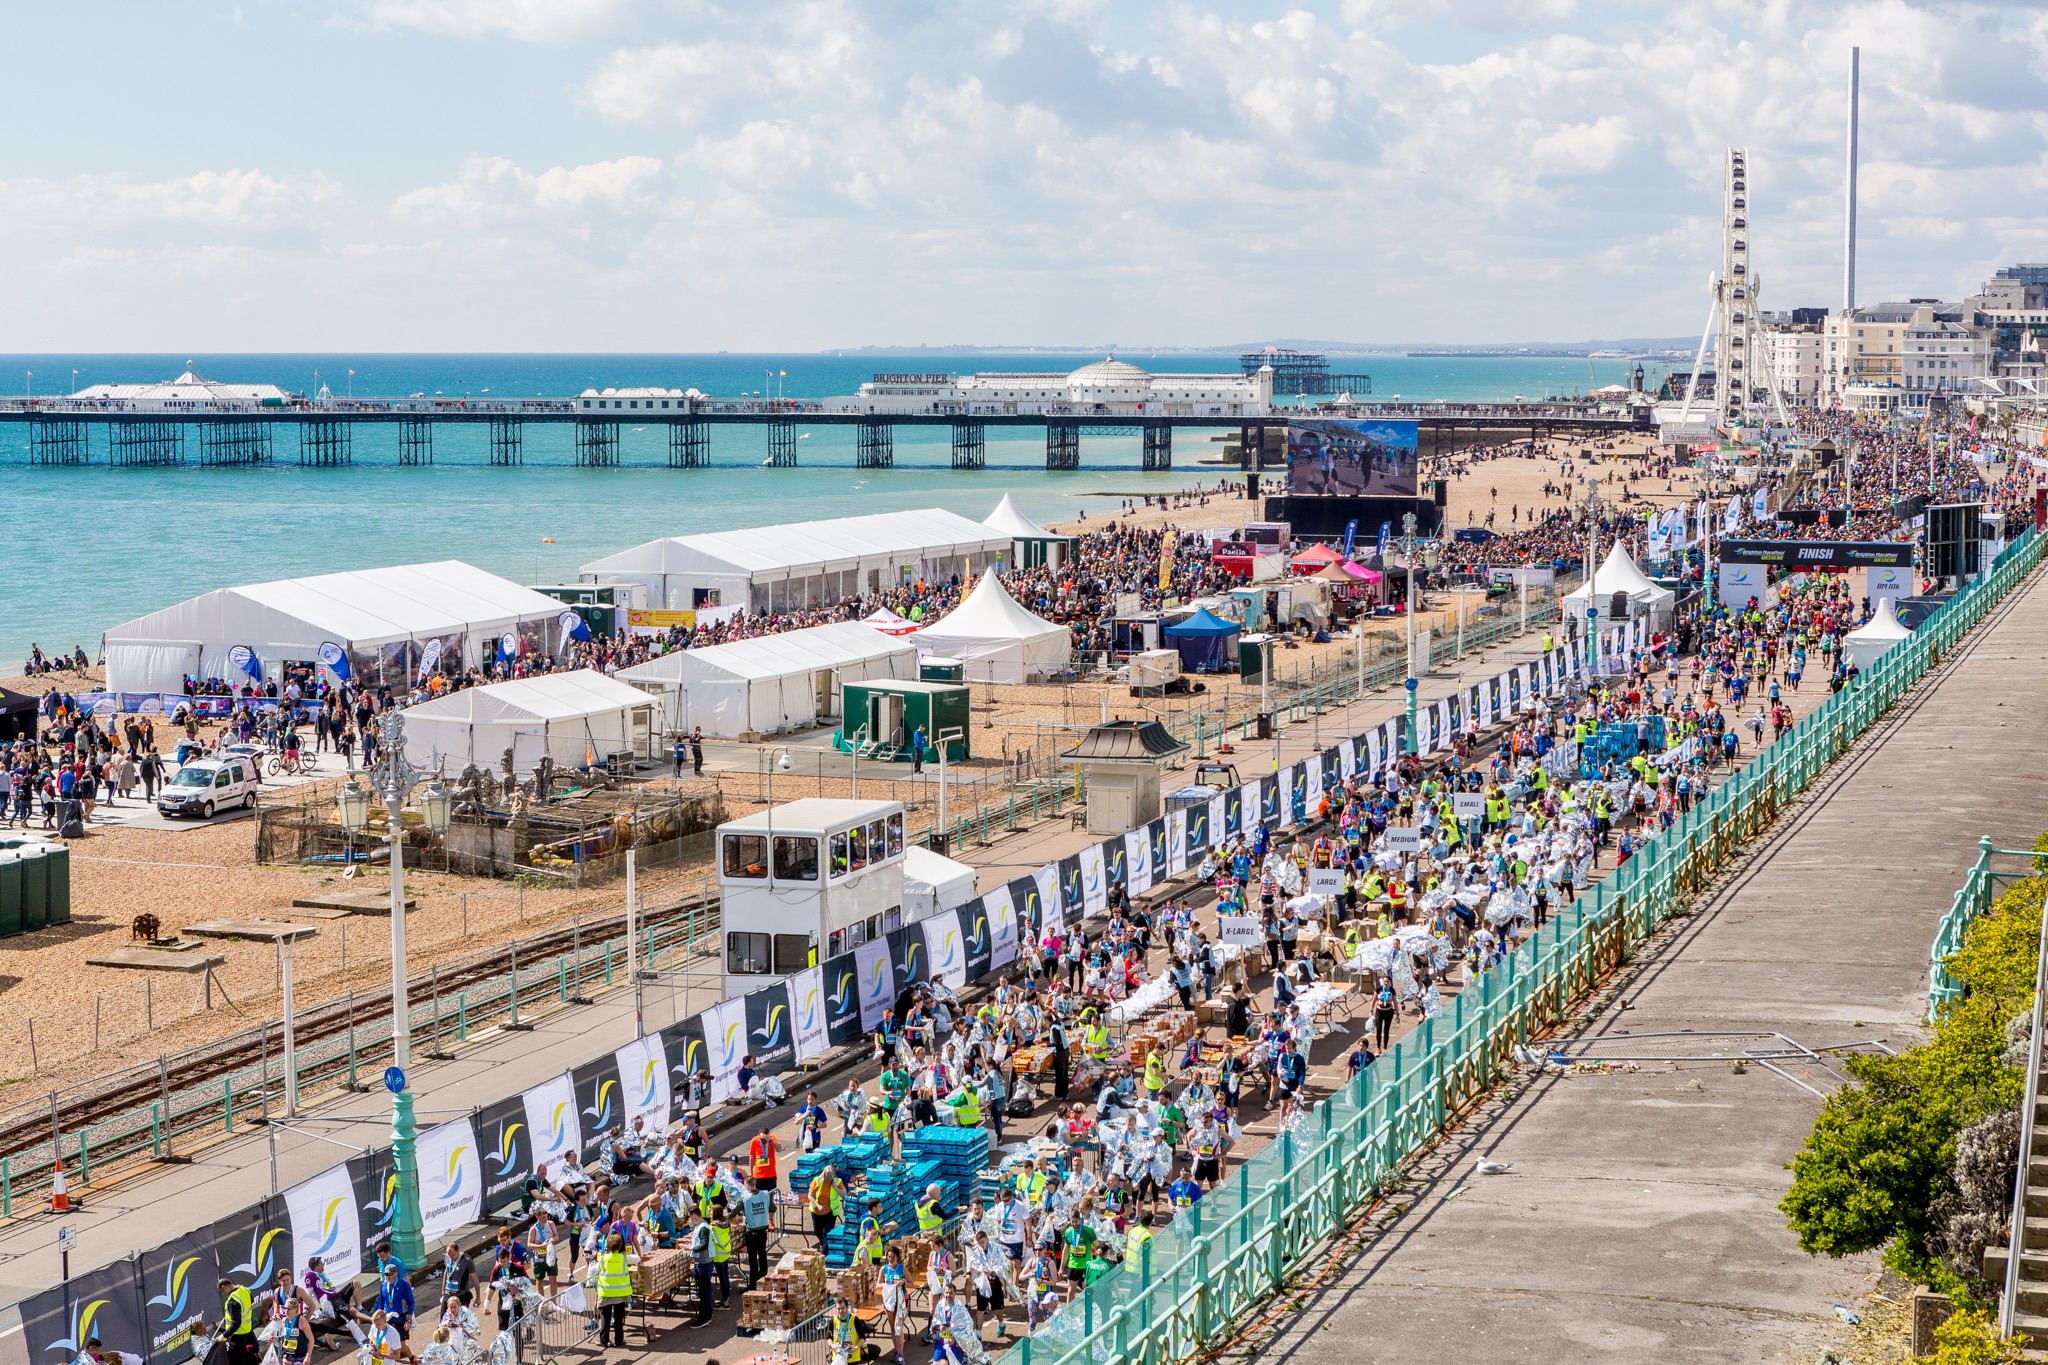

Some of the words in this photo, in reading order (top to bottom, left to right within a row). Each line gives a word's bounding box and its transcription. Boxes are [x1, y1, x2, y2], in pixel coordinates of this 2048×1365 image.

[873, 374, 921, 384] BRIGHTON
[926, 374, 948, 383] PIER
[1222, 548, 1246, 556] Paella
[1798, 548, 1834, 560] FINISH
[1316, 878, 1338, 886] LARGE
[1225, 927, 1255, 936] X-LARGE
[864, 1002, 877, 1013] Brighton
[877, 996, 891, 1007] Marathon
[755, 1052, 773, 1064] Brighton
[772, 1044, 790, 1058] Marathon
[715, 1071, 729, 1083] Brighton
[585, 1134, 602, 1149] Brighton
[486, 1178, 507, 1195] Brighton
[506, 1169, 528, 1186] Marathon
[425, 1206, 449, 1220] Brighton
[449, 1195, 474, 1211] Marathon
[366, 1231, 383, 1248] Brighton
[323, 1247, 353, 1266] Marathon
[153, 1327, 177, 1347] Brighton
[176, 1311, 204, 1335] Marathon
[166, 1329, 192, 1353] WEEKEND
